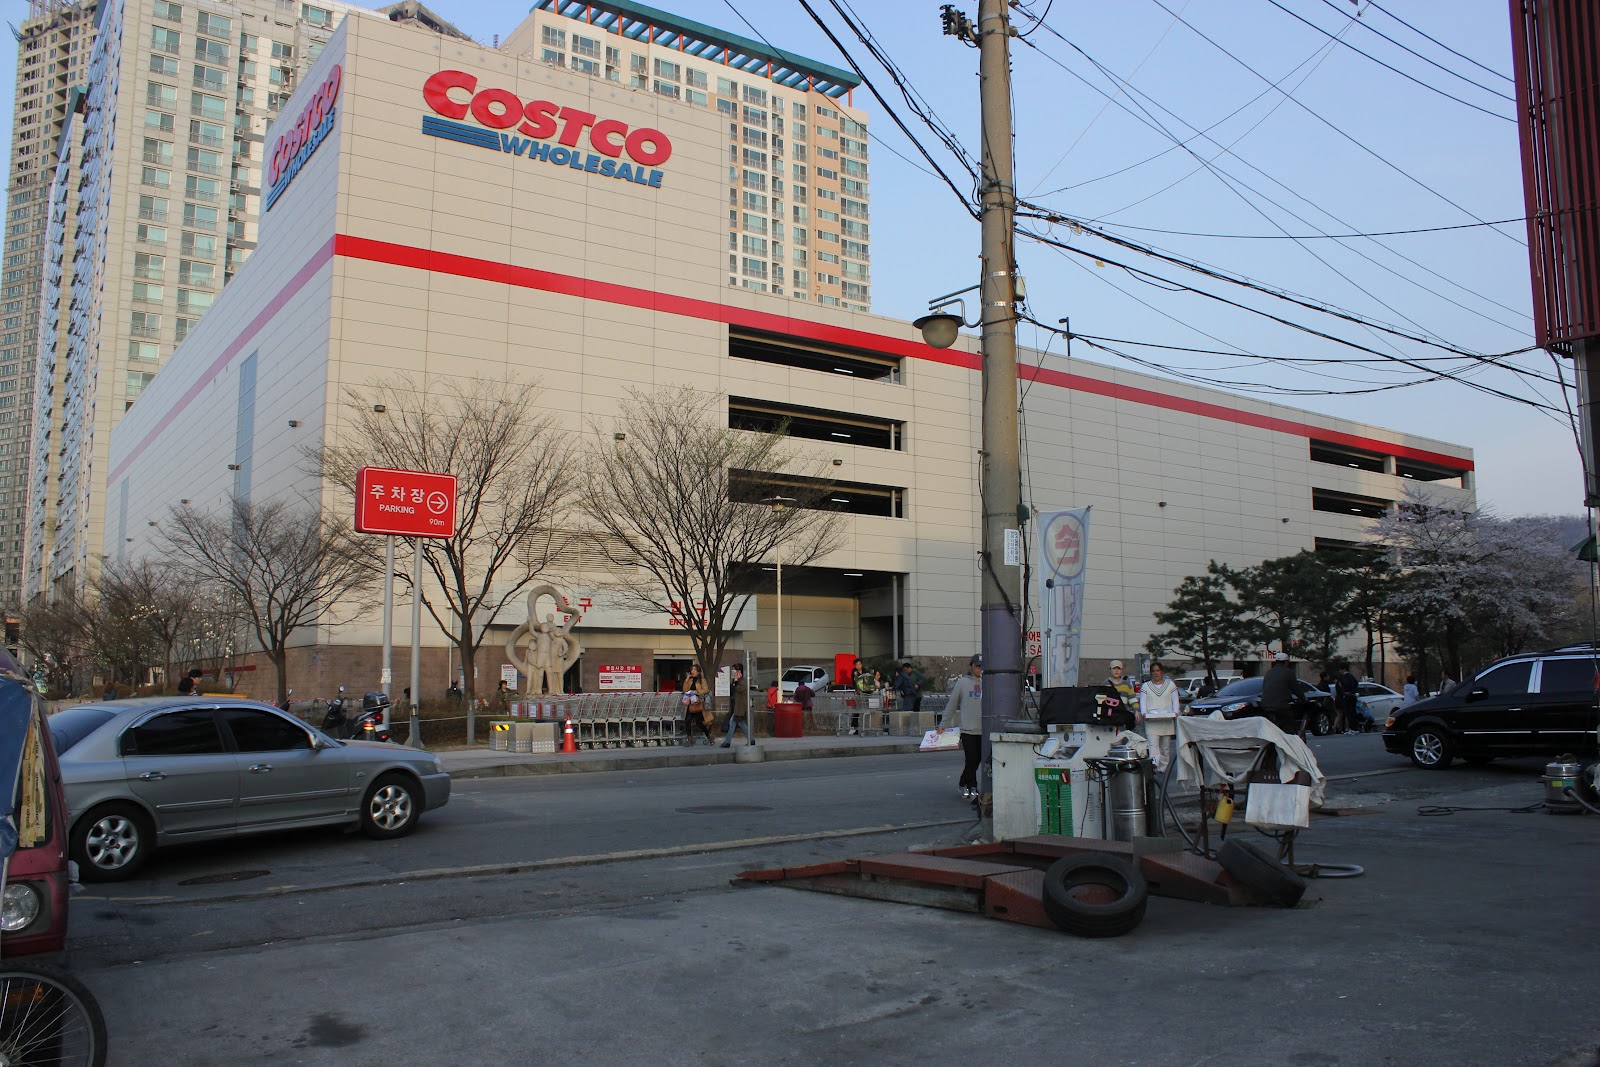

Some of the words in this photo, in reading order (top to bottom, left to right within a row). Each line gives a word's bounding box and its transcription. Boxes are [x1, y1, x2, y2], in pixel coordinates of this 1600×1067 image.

[268, 64, 341, 187] COSTCO
[422, 69, 672, 166] COSTCO
[284, 107, 336, 187] WHOLESALE
[499, 133, 664, 188] WHOLESALE
[370, 484, 425, 503] 주차장
[379, 504, 415, 514] PARKING
[429, 518, 445, 526] 90m
